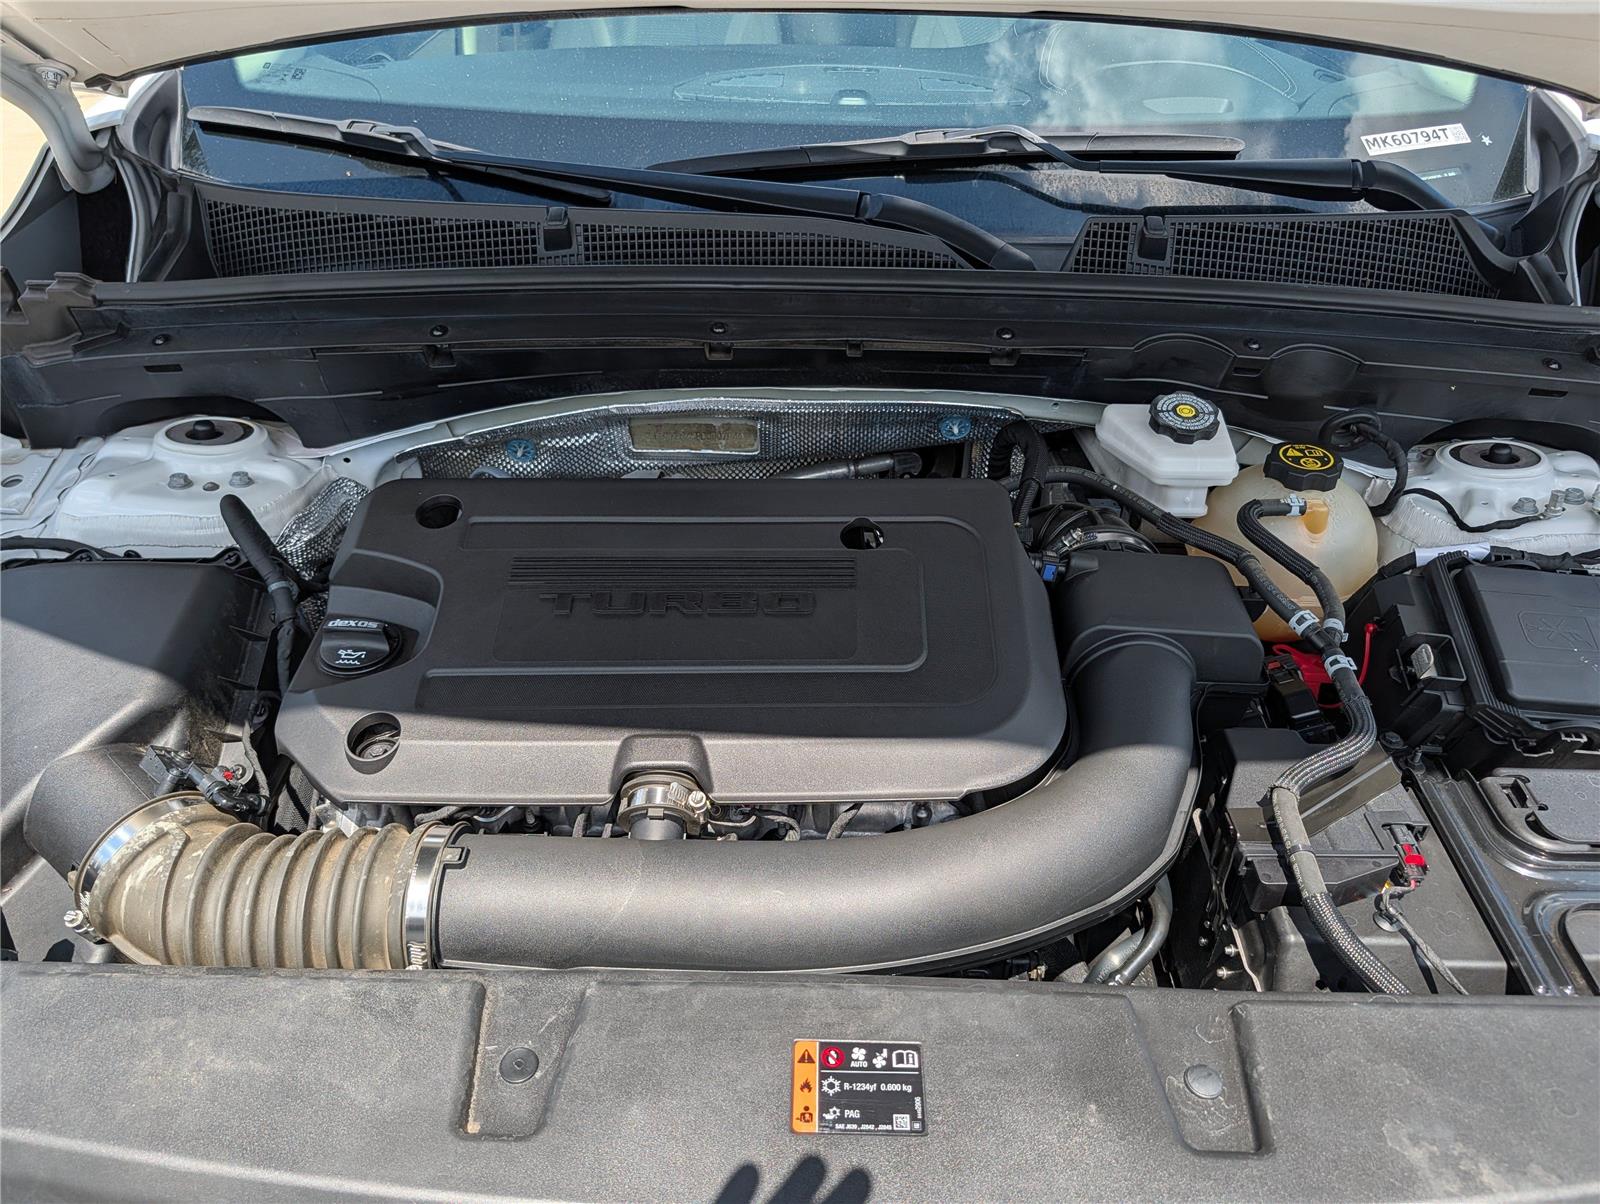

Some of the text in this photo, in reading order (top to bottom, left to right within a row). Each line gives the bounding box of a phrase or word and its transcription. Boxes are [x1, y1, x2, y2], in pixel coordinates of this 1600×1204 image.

[1364, 127, 1449, 149] MK60794T
[539, 590, 816, 616] TURBO
[327, 619, 378, 629] dexos
[843, 1082, 912, 1093] R-1234yf 0.600 kg
[844, 1109, 860, 1118] PAG
